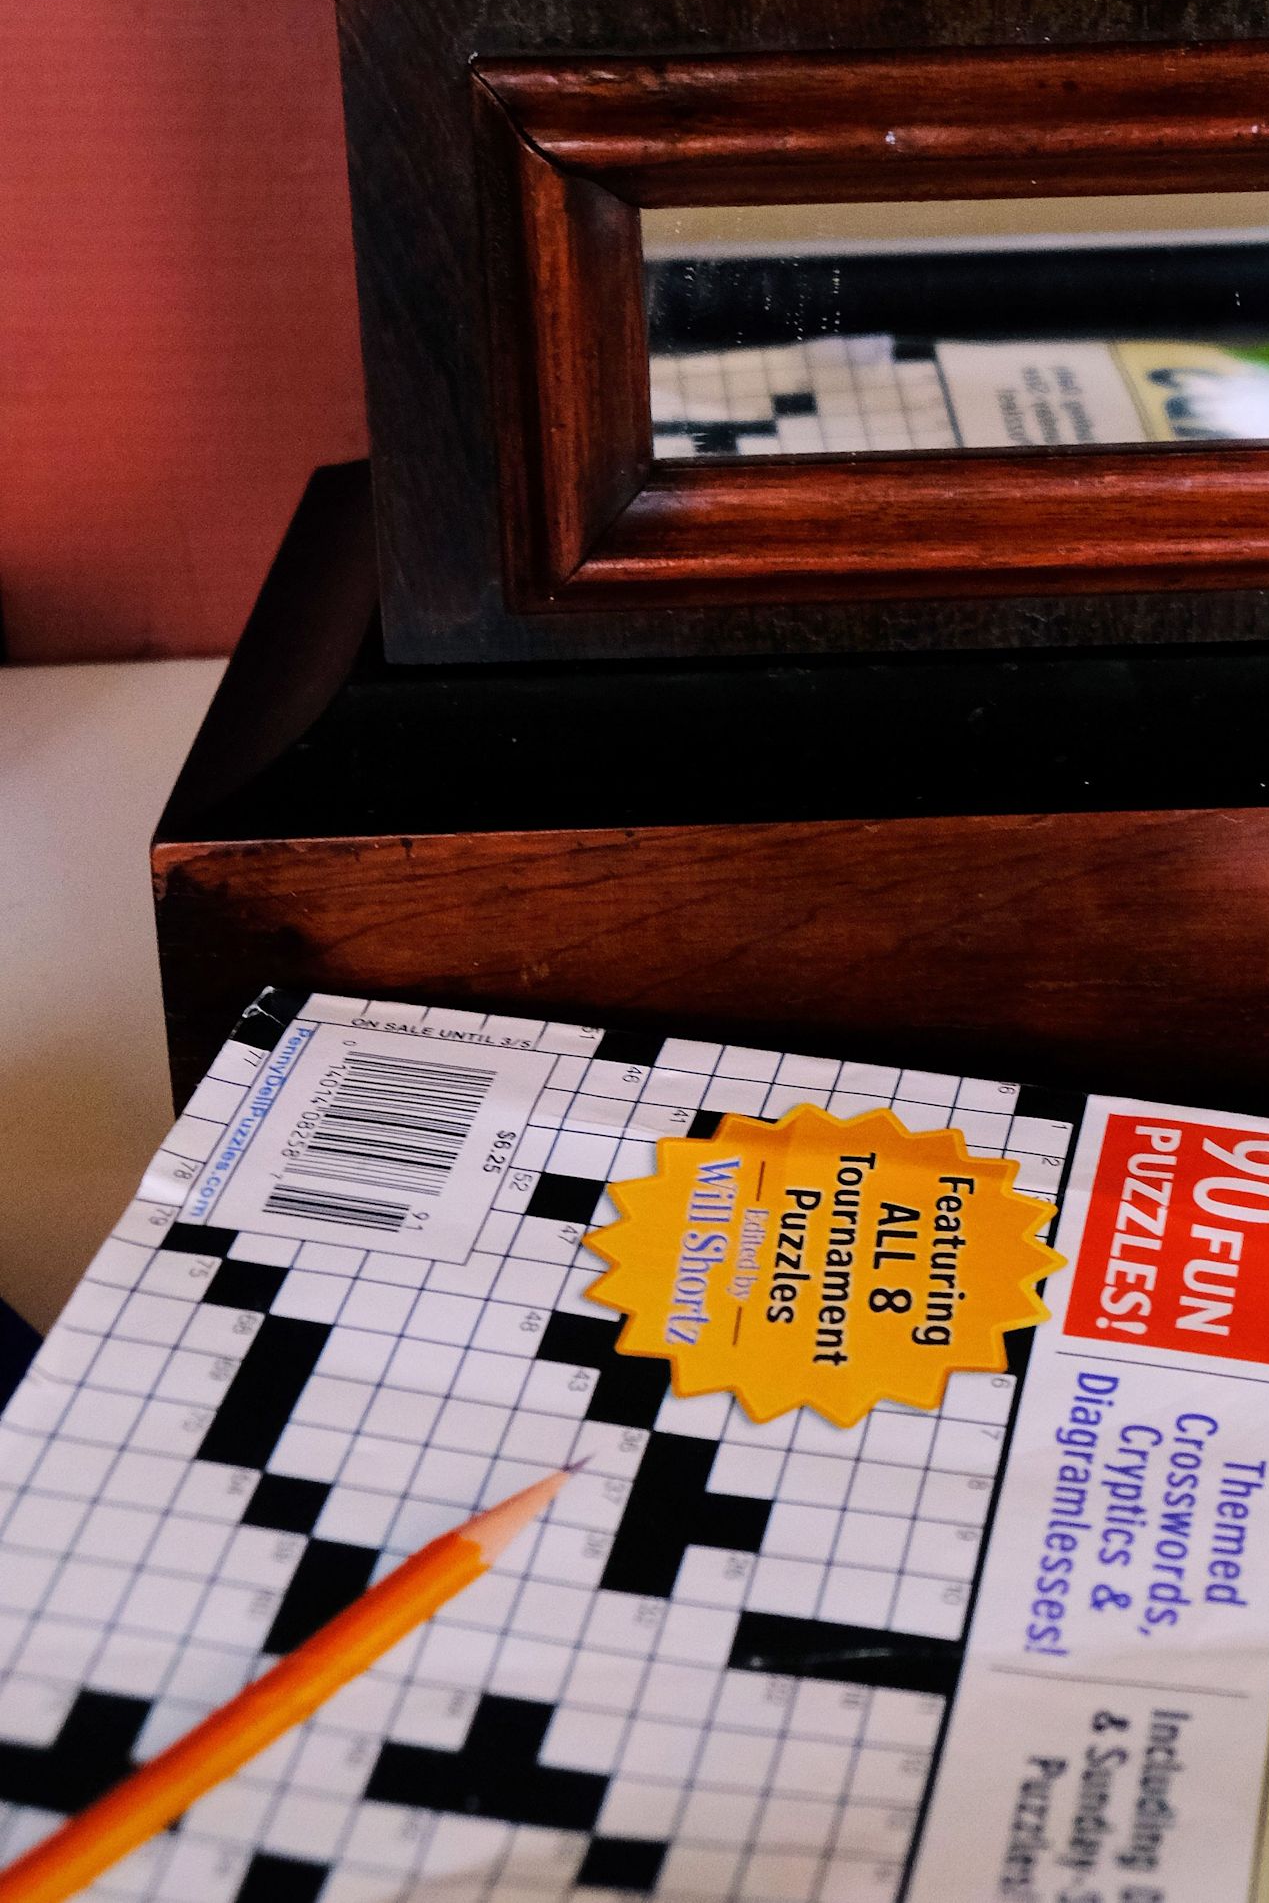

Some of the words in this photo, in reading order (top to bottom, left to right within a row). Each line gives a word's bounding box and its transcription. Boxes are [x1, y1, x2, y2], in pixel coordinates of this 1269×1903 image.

[351, 1018, 380, 1030] ON
[384, 1022, 433, 1037] SALE
[439, 1029, 494, 1045] UNTIL
[500, 1038, 531, 1048] 3/5
[243, 1050, 265, 1068] 77
[622, 1066, 644, 1084] 46
[191, 1027, 315, 1218] PennyDellPuzzles.com
[669, 1109, 691, 1125] 41
[483, 1129, 517, 1174] $6.25
[1041, 1156, 1060, 1167] 2
[173, 1161, 197, 1181] 78
[512, 1172, 533, 1193] 52
[687, 1157, 742, 1224] Will
[150, 1208, 176, 1227] 79
[408, 1211, 430, 1232] 91
[1095, 1123, 1181, 1336] PUZZLES!
[560, 1225, 580, 1245] 47
[737, 1209, 770, 1271] Edited
[872, 1200, 923, 1270] ALL
[189, 1258, 215, 1279] 75
[765, 1187, 821, 1326] Puzzles
[812, 1151, 877, 1367] Tournament
[909, 1173, 976, 1348] Featuring
[664, 1231, 729, 1345] Shortz
[727, 1276, 759, 1300] by
[1176, 1226, 1243, 1336] FUN
[869, 1286, 914, 1316] 8
[519, 1311, 544, 1333] 48
[567, 1368, 592, 1393] 43
[1099, 1424, 1163, 1567] Cryptics
[1024, 1371, 1119, 1657] Diagramlesses!
[1138, 1412, 1219, 1635] Crosswords,
[1205, 1459, 1267, 1607] Themed
[1090, 1583, 1132, 1612] &
